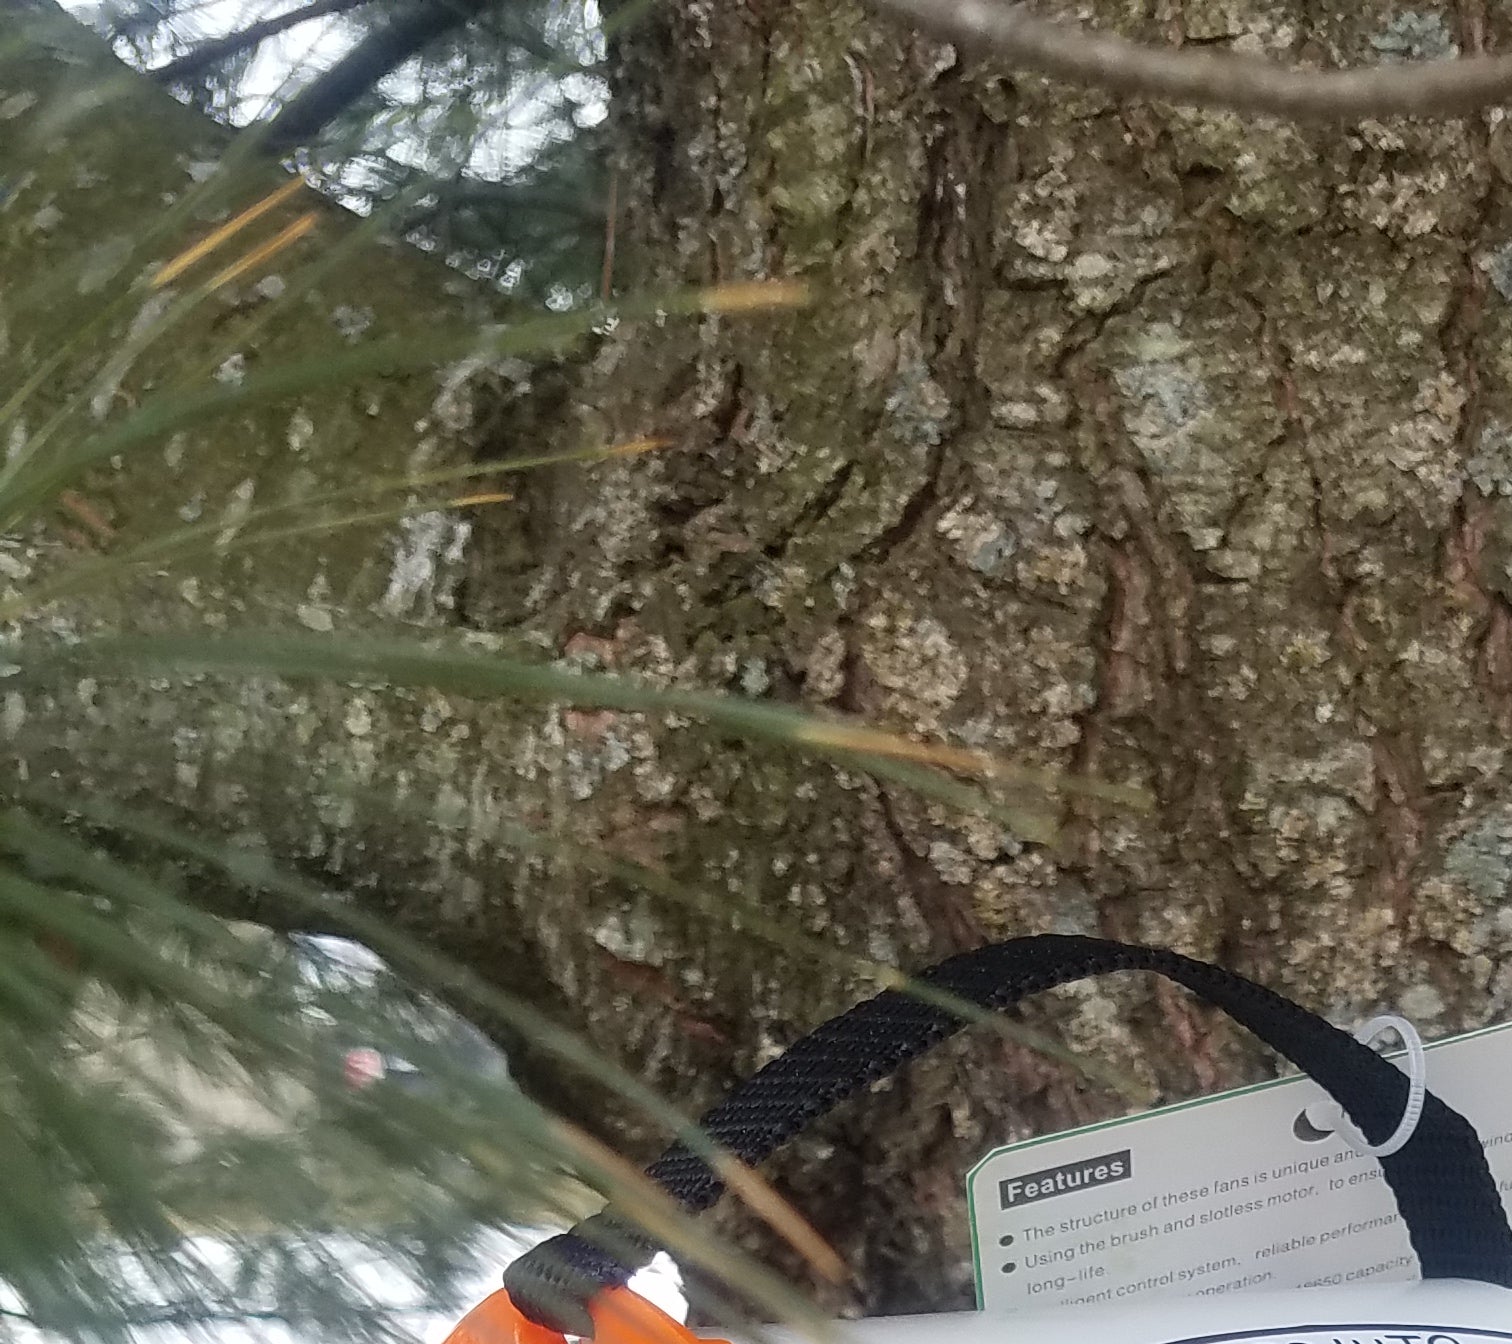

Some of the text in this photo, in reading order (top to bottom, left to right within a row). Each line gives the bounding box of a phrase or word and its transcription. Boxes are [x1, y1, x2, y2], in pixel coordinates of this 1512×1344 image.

[1007, 1160, 1124, 1203] Features
[1023, 1224, 1055, 1242] The
[1060, 1204, 1137, 1233] structure
[1142, 1195, 1159, 1212] of
[1162, 1184, 1209, 1207] these
[1214, 1174, 1249, 1194] fans
[1254, 1170, 1267, 1184] is
[1272, 1155, 1330, 1179] unique
[1024, 1245, 1075, 1269] Using
[1080, 1236, 1106, 1255] the
[1110, 1224, 1159, 1247] brush
[1164, 1214, 1195, 1233] and
[1200, 1198, 1263, 1225] slotless
[1329, 1177, 1344, 1191] to
[1348, 1168, 1386, 1186] ensu
[1116, 1271, 1174, 1297] control
[1255, 1235, 1315, 1259] reliable
